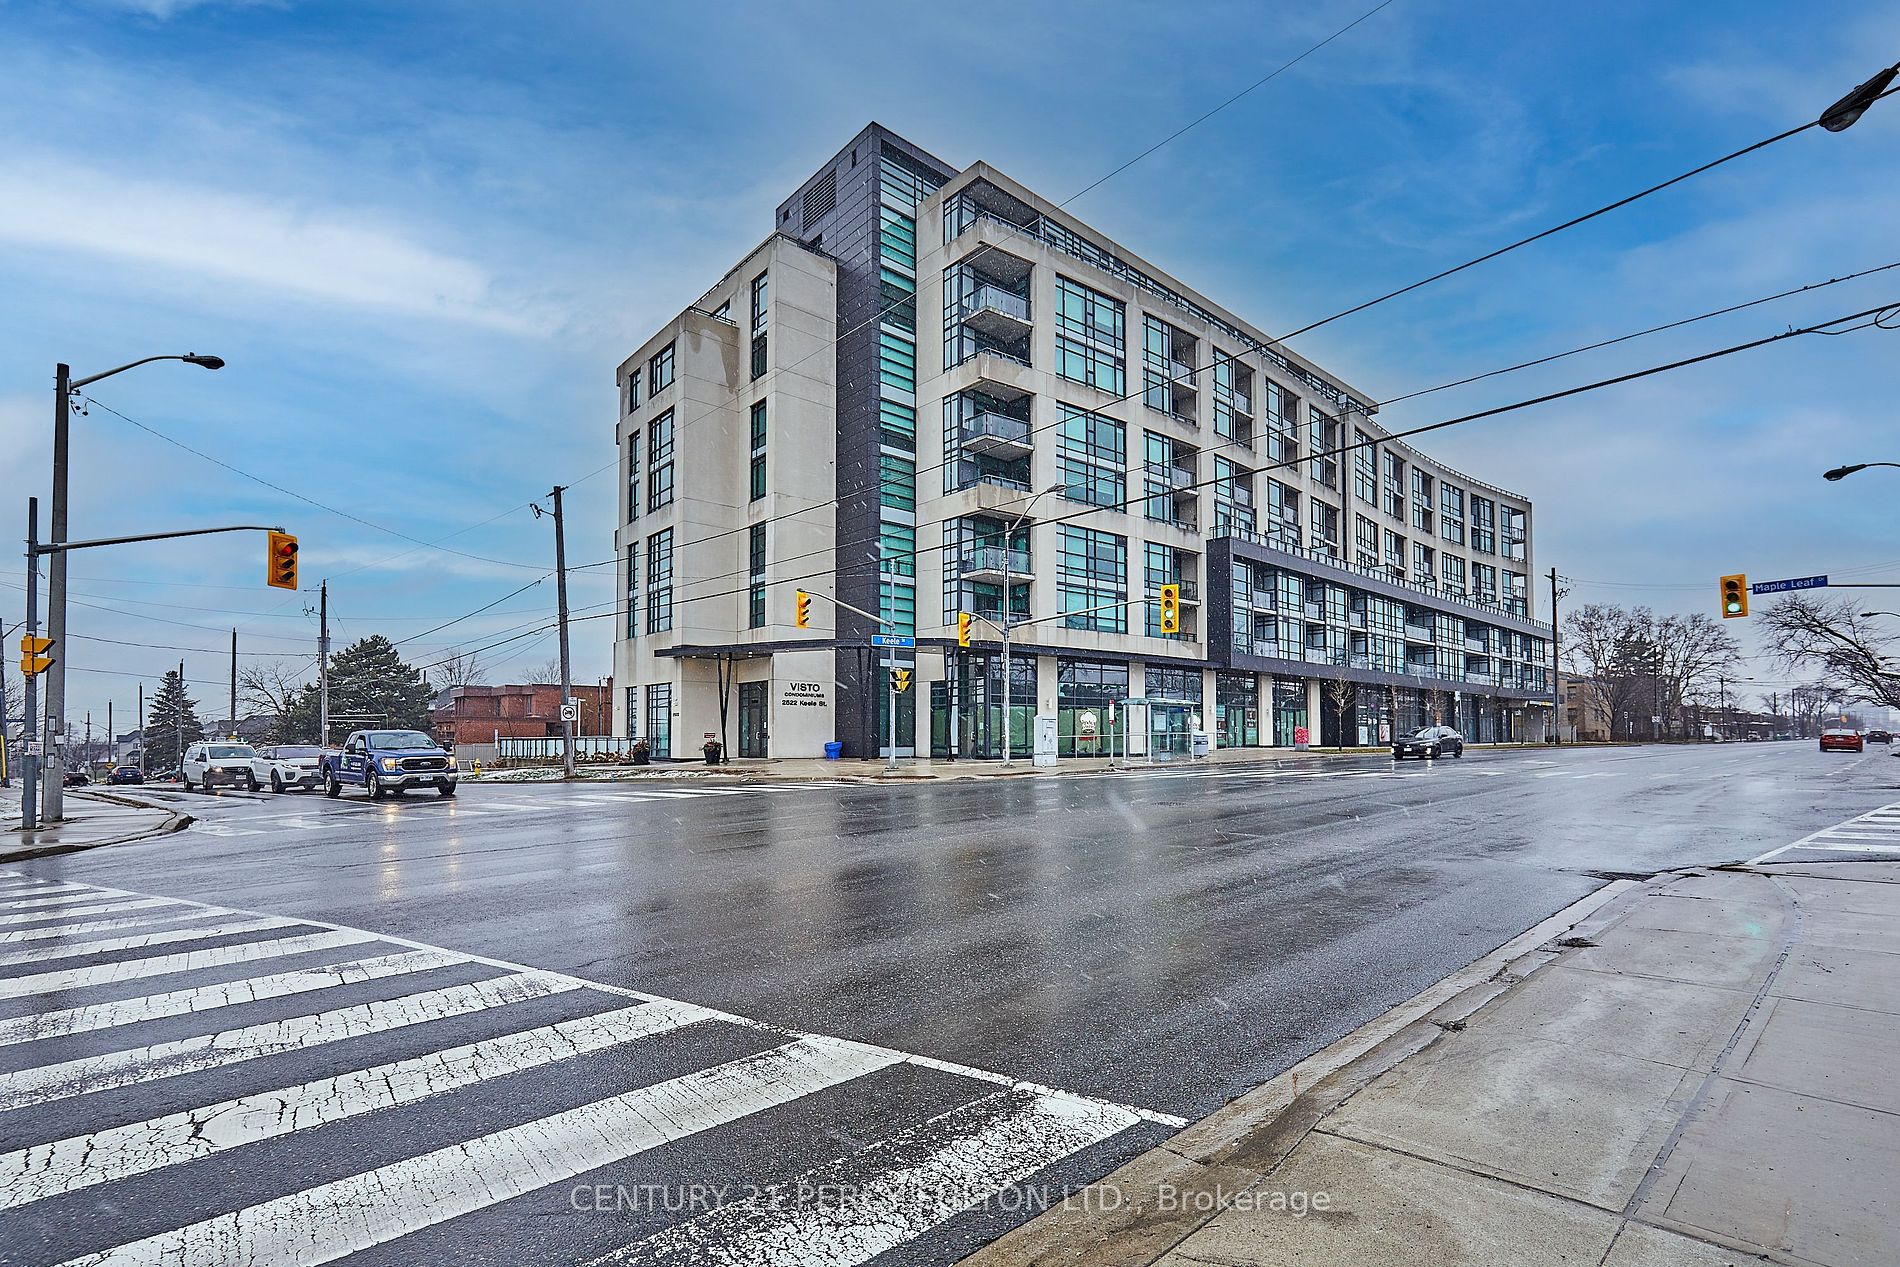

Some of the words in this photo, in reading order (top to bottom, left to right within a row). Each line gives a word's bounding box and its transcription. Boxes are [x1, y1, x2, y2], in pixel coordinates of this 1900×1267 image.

[1755, 582, 1787, 592] Maple
[1791, 578, 1815, 588] Leaf
[882, 637, 900, 645] Keele
[790, 683, 820, 692] VISTO
